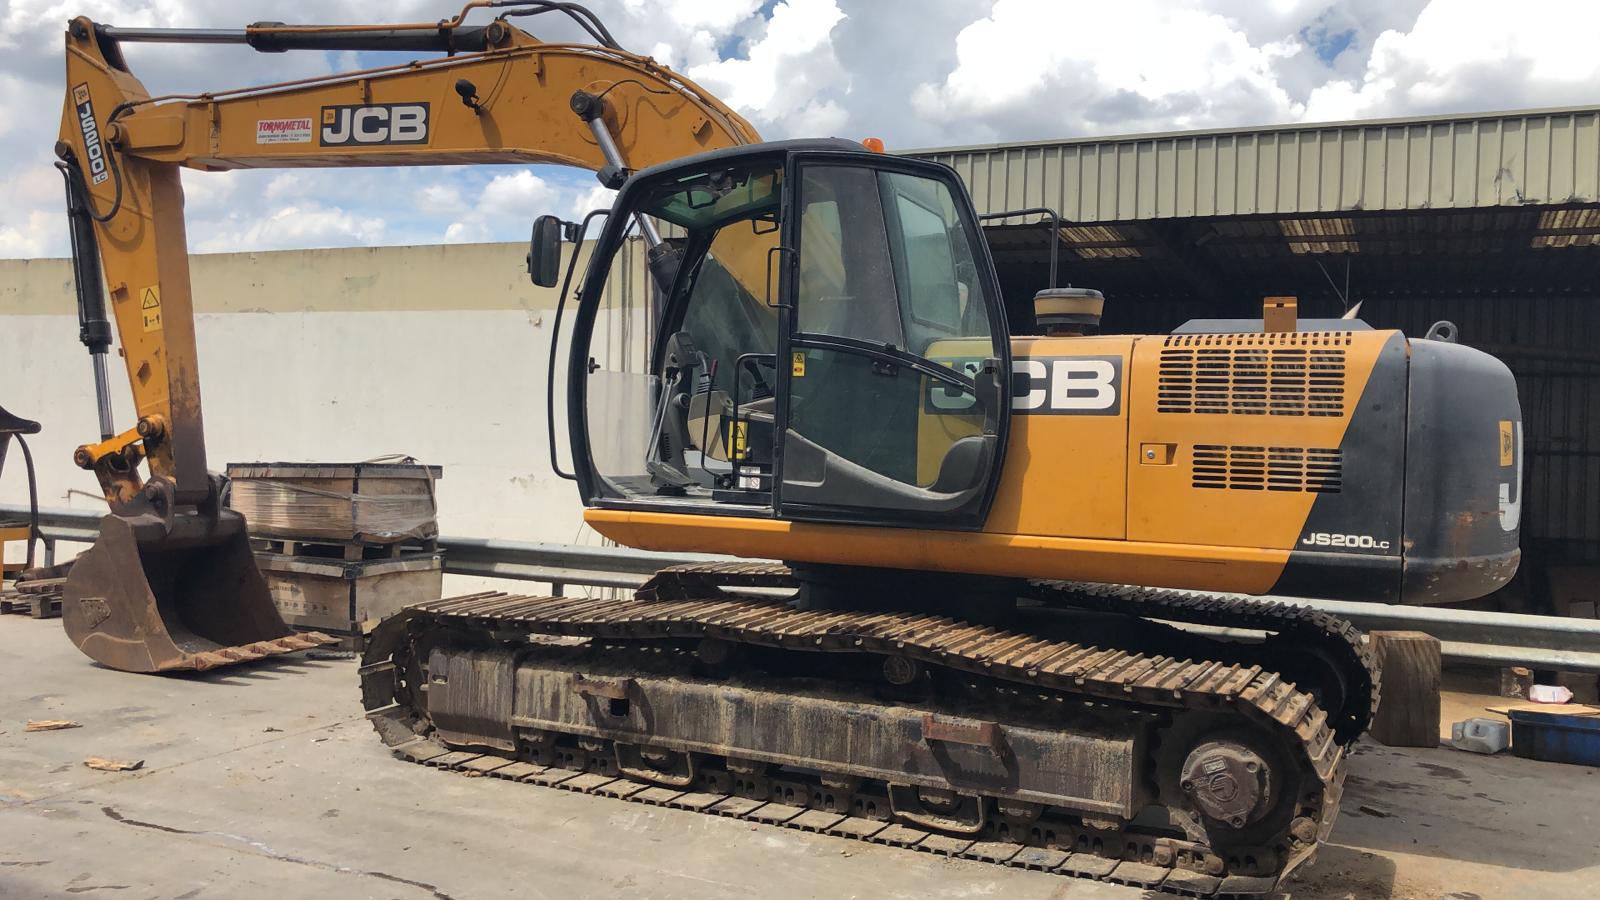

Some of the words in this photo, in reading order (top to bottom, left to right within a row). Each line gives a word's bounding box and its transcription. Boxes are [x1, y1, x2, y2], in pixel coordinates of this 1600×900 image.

[258, 120, 311, 133] TORNOMETAL
[323, 106, 427, 143] JCB
[1302, 532, 1390, 549] JS200LC
